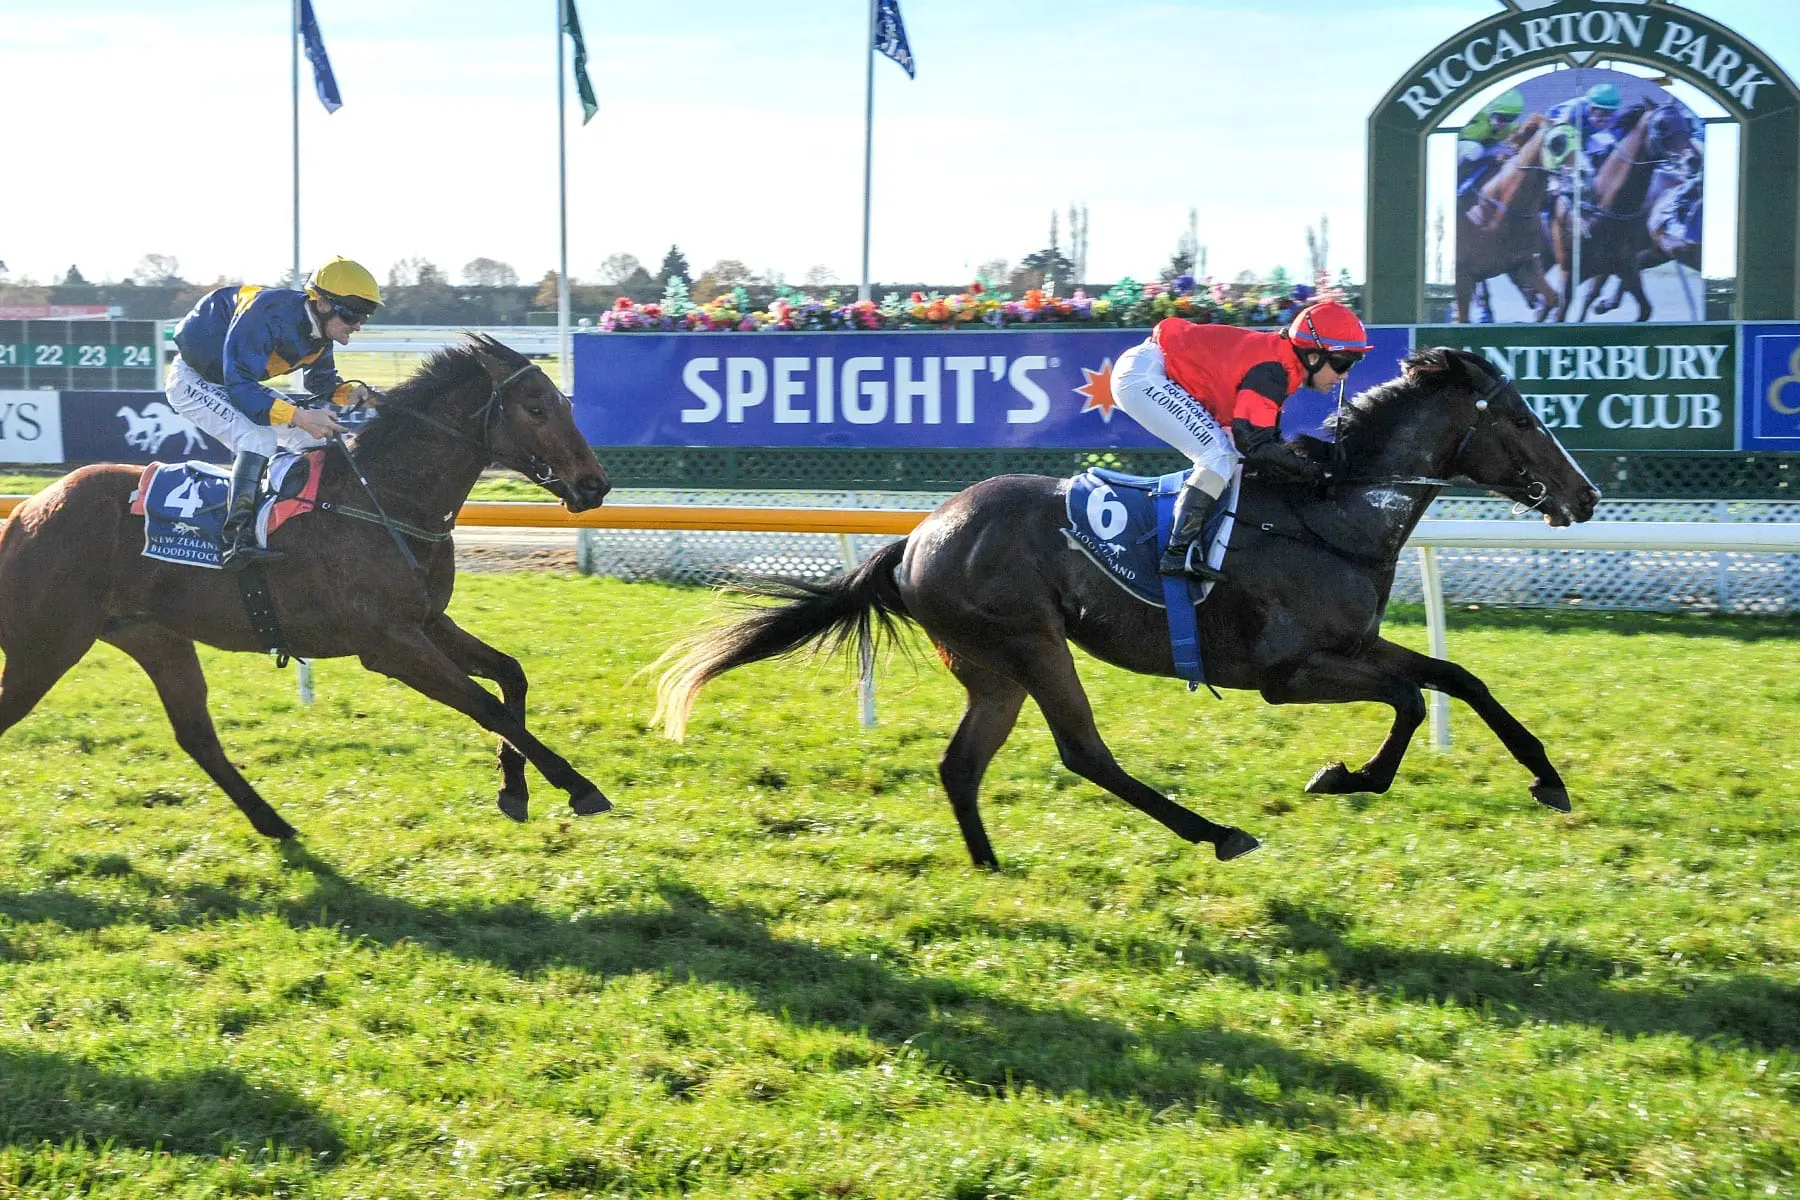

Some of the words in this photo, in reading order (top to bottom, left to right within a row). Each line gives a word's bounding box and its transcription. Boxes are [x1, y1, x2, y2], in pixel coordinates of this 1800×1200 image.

[1397, 10, 1652, 120] RICCARTON
[1655, 20, 1777, 110] PARK
[35, 345, 63, 365] 22
[78, 345, 107, 366] 23
[123, 346, 152, 366] 24
[1431, 344, 1728, 380] NTERBURY
[184, 384, 238, 423] MOSELEY
[680, 355, 1052, 424] SPEIGHT'S
[1162, 383, 1215, 430] EQUIWORLD
[1598, 393, 1723, 430] CLUB
[163, 476, 203, 519] 4
[1086, 484, 1128, 541] 6
[150, 544, 220, 562] BLOODSTOCK
[151, 536, 175, 545] NEW
